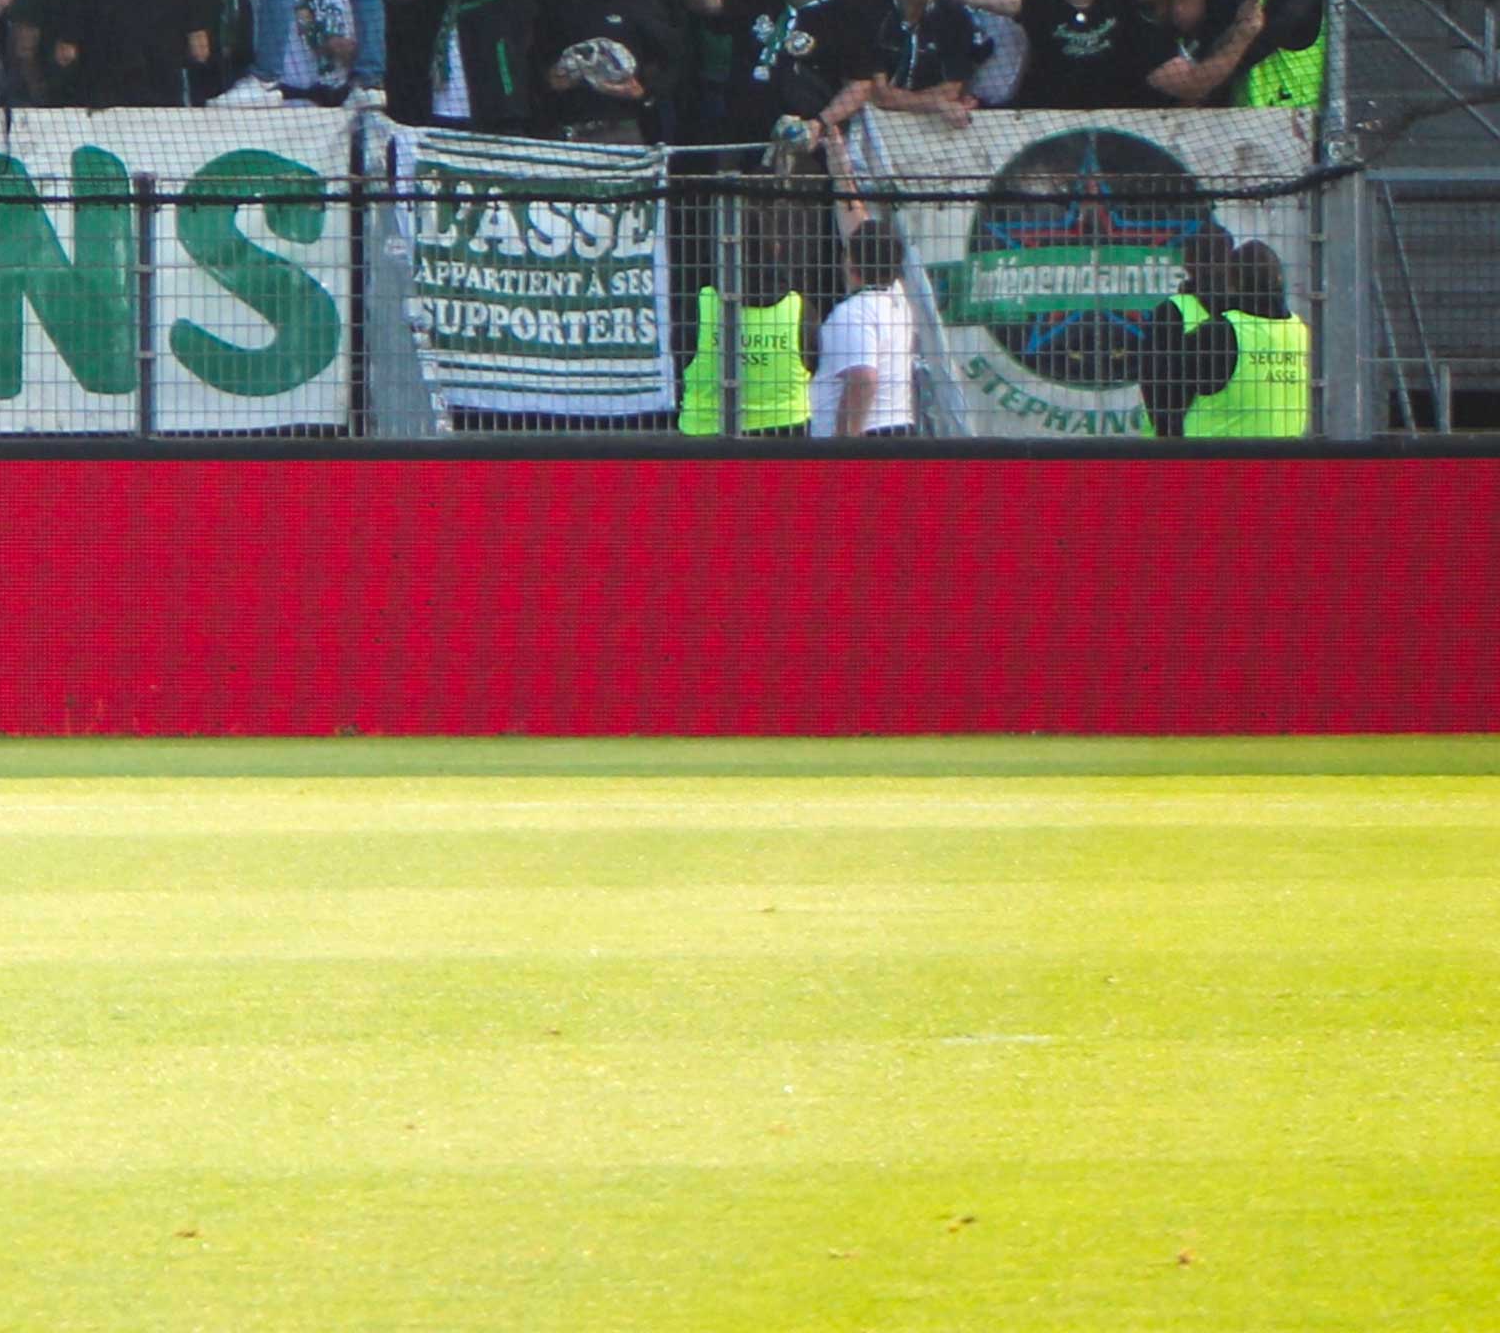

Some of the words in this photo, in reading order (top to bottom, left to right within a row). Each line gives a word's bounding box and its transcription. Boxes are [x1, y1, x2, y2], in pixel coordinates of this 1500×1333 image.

[415, 178, 655, 260] L'ASSE
[414, 257, 583, 298] APPARTIENT
[610, 267, 654, 296] SES
[711, 332, 789, 351] SURITÉ
